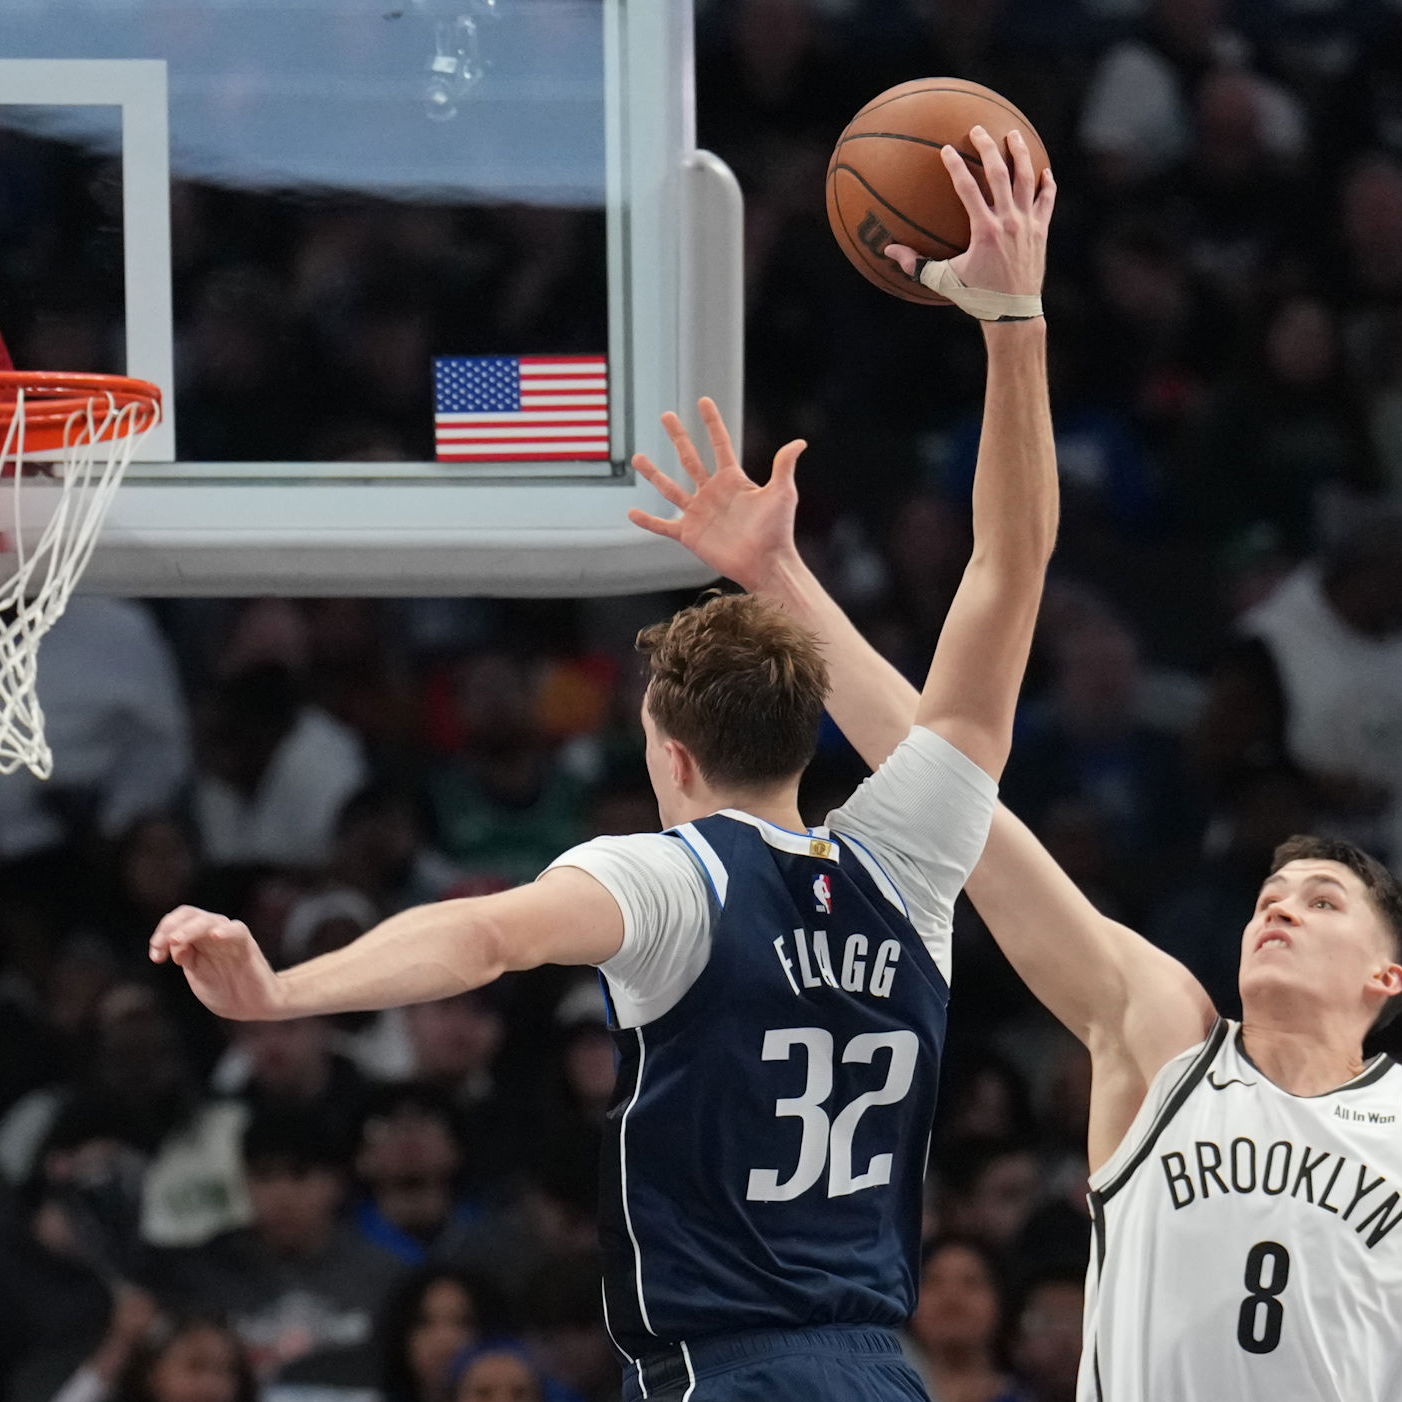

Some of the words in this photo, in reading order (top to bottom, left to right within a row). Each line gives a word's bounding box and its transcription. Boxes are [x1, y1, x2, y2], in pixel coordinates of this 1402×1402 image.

[773, 928, 901, 998] FLAGG
[746, 1027, 919, 1201] 32
[1334, 1104, 1350, 1120] All
[1353, 1110, 1365, 1121] In
[1237, 1241, 1290, 1354] 8
